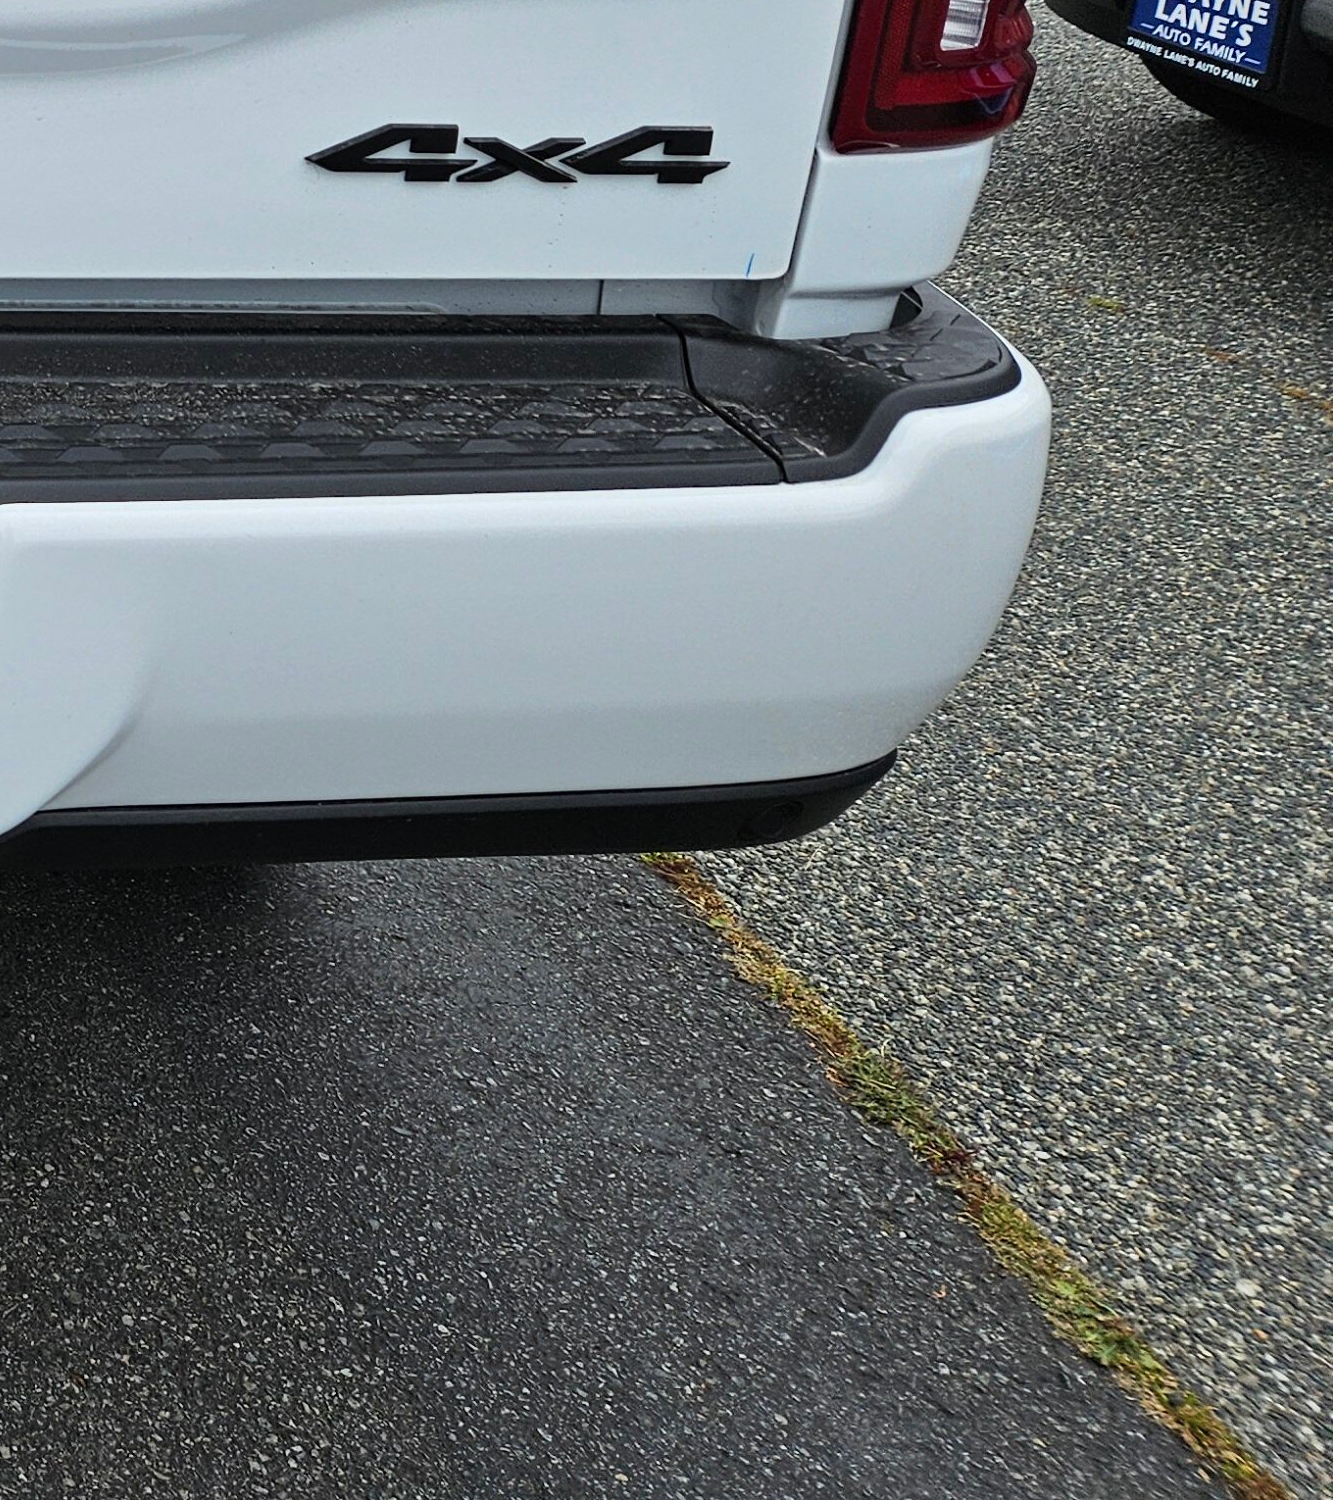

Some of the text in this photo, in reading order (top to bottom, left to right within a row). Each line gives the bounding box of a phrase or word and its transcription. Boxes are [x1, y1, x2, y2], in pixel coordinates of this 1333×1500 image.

[1126, 36, 1163, 56] DWAYNE
[1195, 60, 1221, 76] AUTO
[1221, 69, 1259, 88] FAMILY
[1152, 24, 1247, 64] AUTO FAMILY
[304, 123, 731, 184] 4x4
